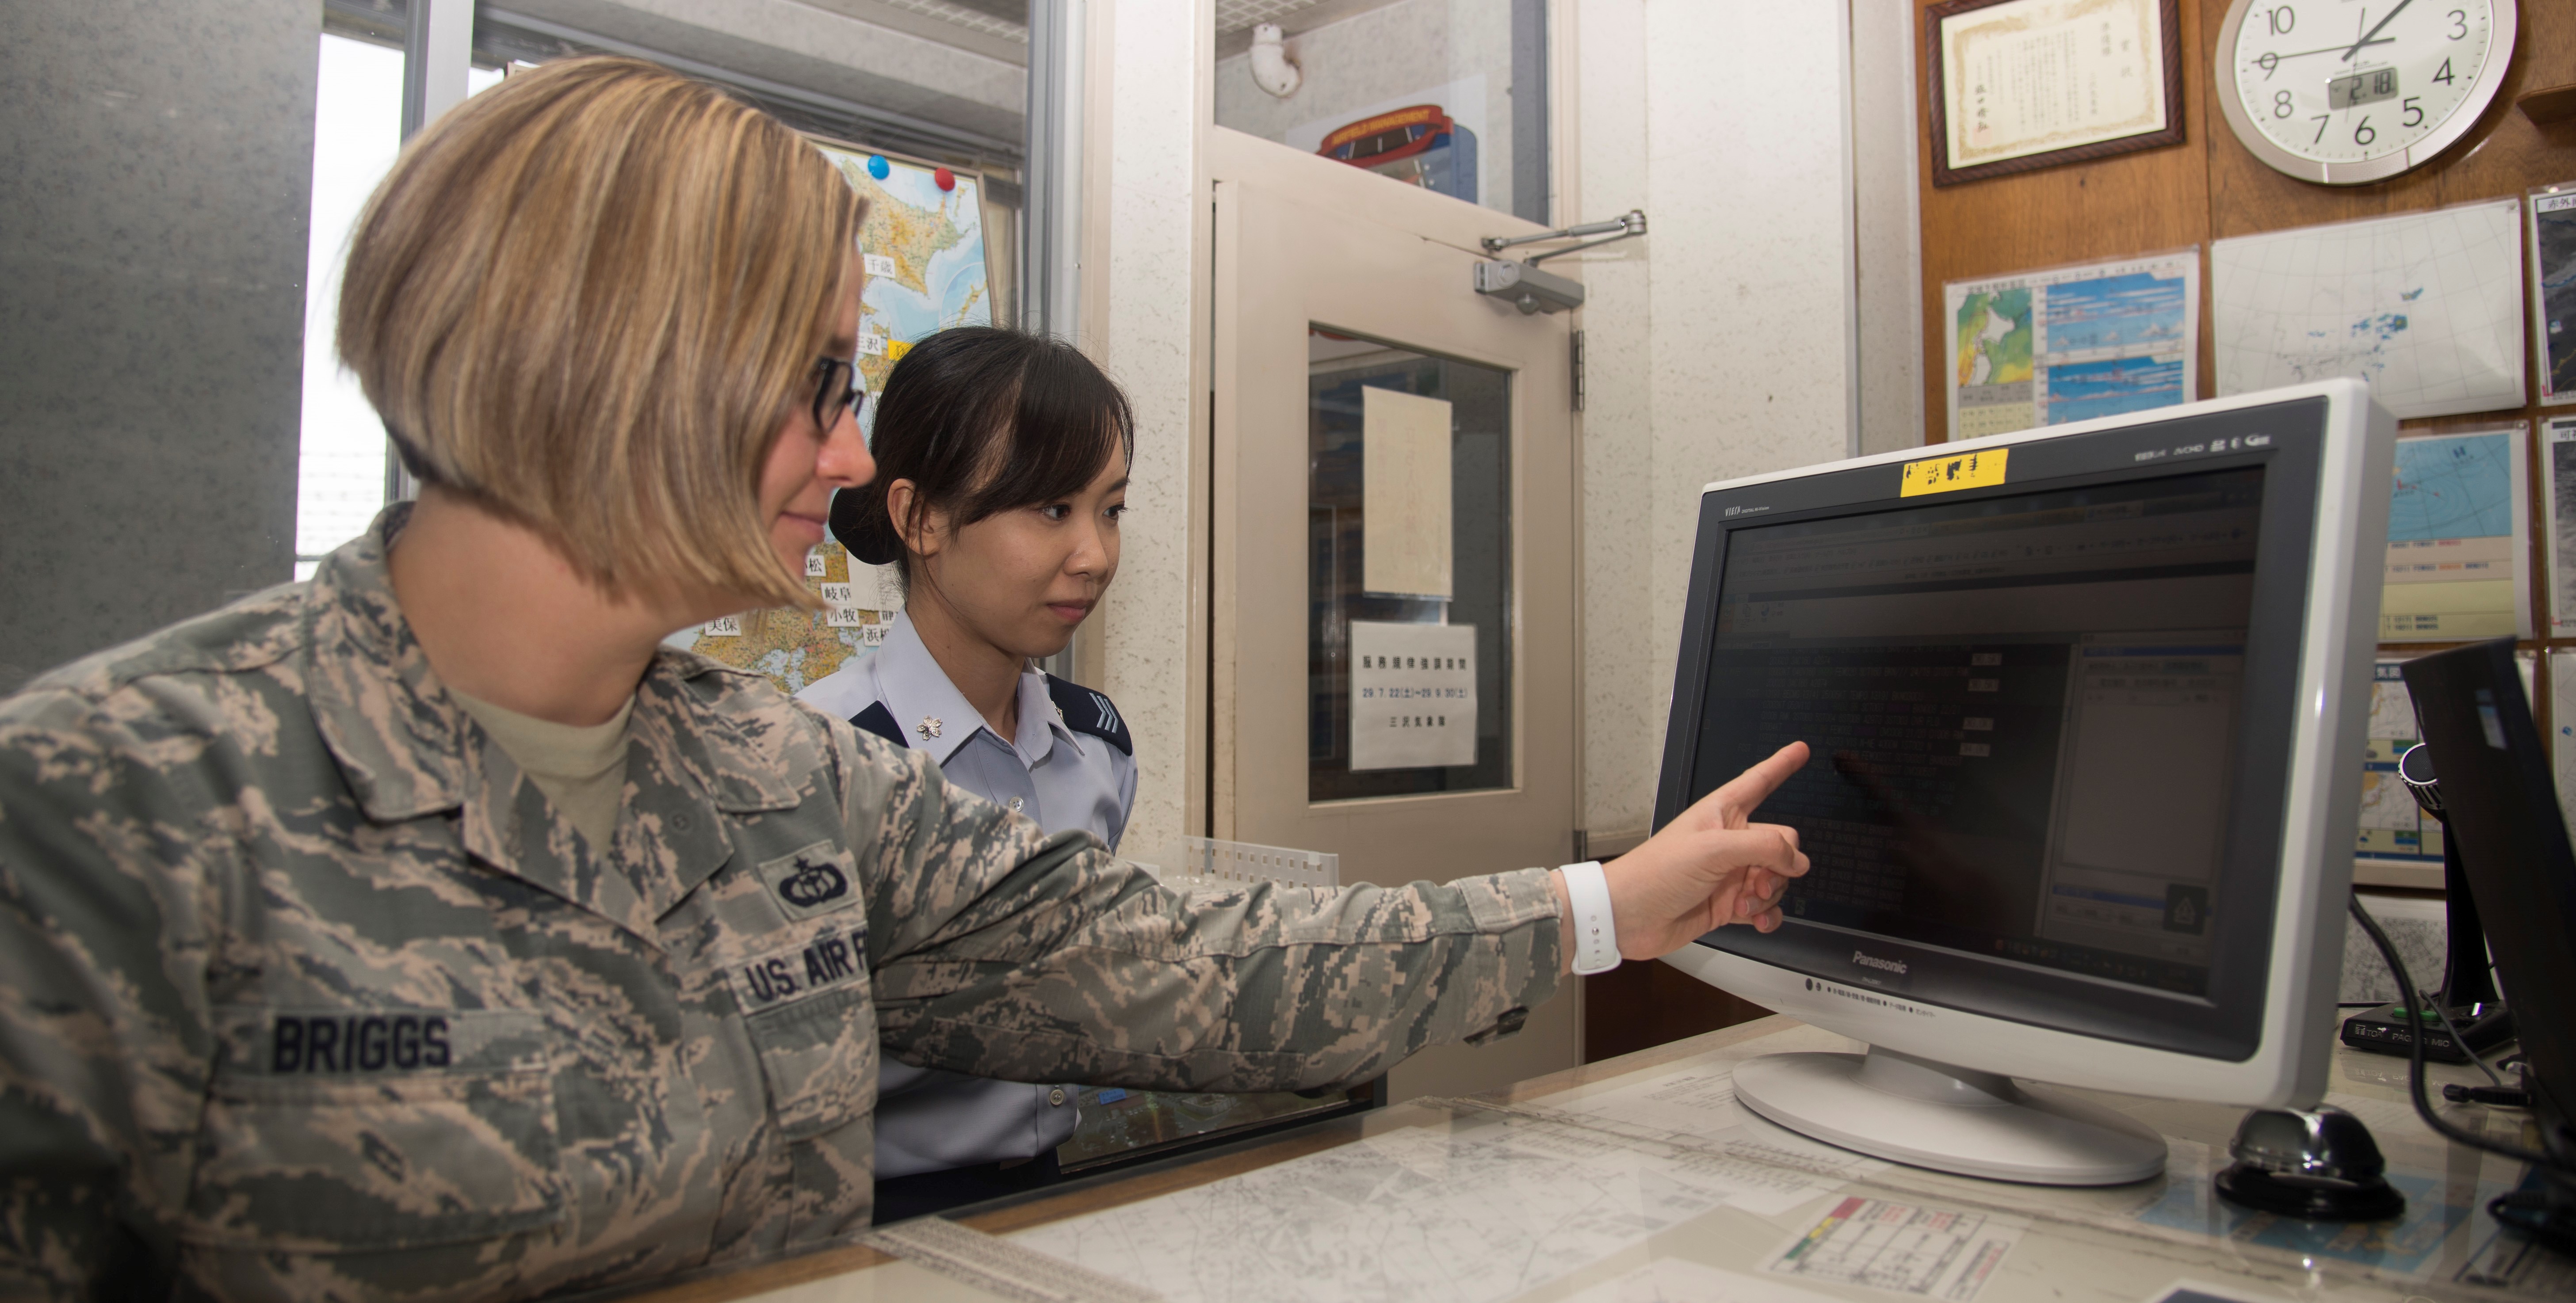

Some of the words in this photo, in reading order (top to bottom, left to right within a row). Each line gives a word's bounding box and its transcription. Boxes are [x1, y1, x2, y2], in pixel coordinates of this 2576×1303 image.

[2267, 6, 2294, 35] 10
[2446, 10, 2468, 41] 3
[2259, 52, 2278, 82] 9
[2432, 57, 2455, 86] 4
[2274, 90, 2293, 119] 8
[2402, 96, 2423, 127] 5
[1369, 109, 1431, 131] MANAGEMENT
[2311, 114, 2330, 145] 7
[2354, 116, 2376, 145] 6
[867, 259, 893, 274] 千歳
[1725, 506, 1740, 517] VIERA
[804, 558, 823, 573] 松
[825, 586, 851, 601] 岐阜
[707, 617, 738, 632] 美保
[830, 609, 857, 623] 小牧
[803, 939, 854, 986] AIR
[1852, 951, 1907, 974] Panasonic
[272, 1016, 451, 1073] BRIGGS
[2366, 1029, 2382, 1038] TOA
[2431, 1039, 2450, 1047] MIC
